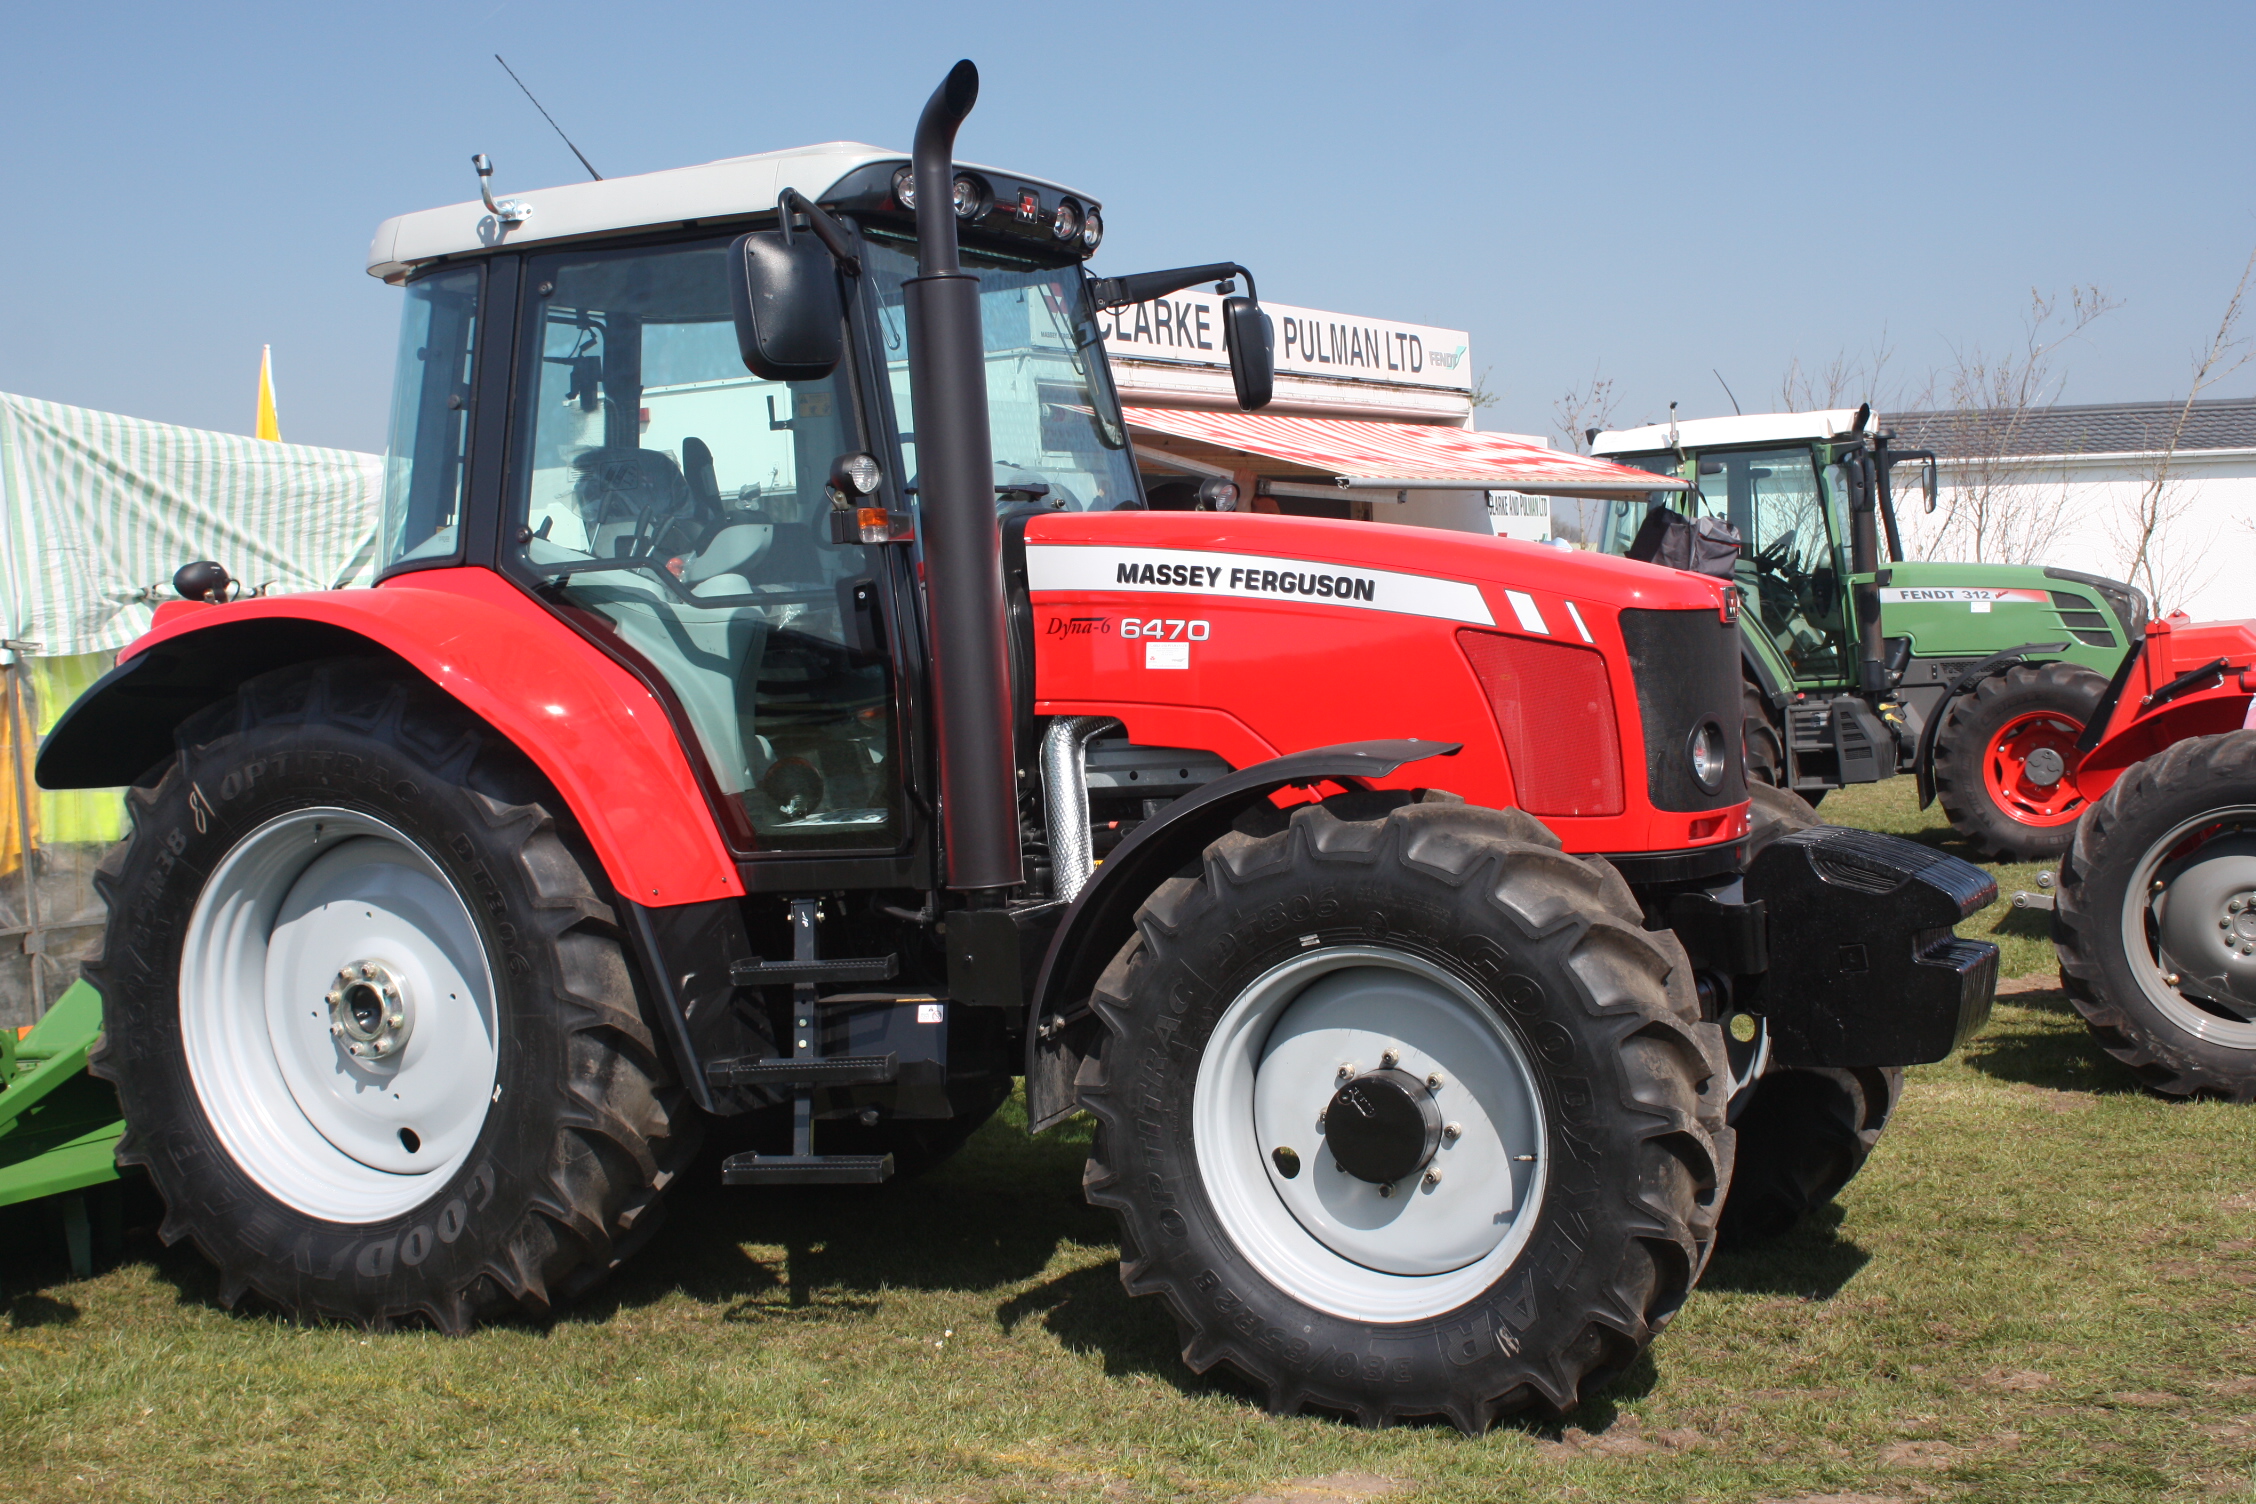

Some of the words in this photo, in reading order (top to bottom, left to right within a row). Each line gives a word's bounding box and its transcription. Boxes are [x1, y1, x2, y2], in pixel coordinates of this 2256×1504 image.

[1283, 316, 1380, 369] PULMAN
[1385, 330, 1423, 373] LTD
[1428, 350, 1459, 369] FENDT
[1116, 562, 1222, 588] MASSEY
[1229, 567, 1376, 602] FERGUSON
[1899, 590, 1955, 600] FENDT
[1961, 590, 1991, 600] 312
[1046, 616, 1113, 640] Dyna-6
[1119, 617, 1211, 641] 6470
[448, 830, 531, 978] DT806
[1211, 884, 1342, 969] DT806
